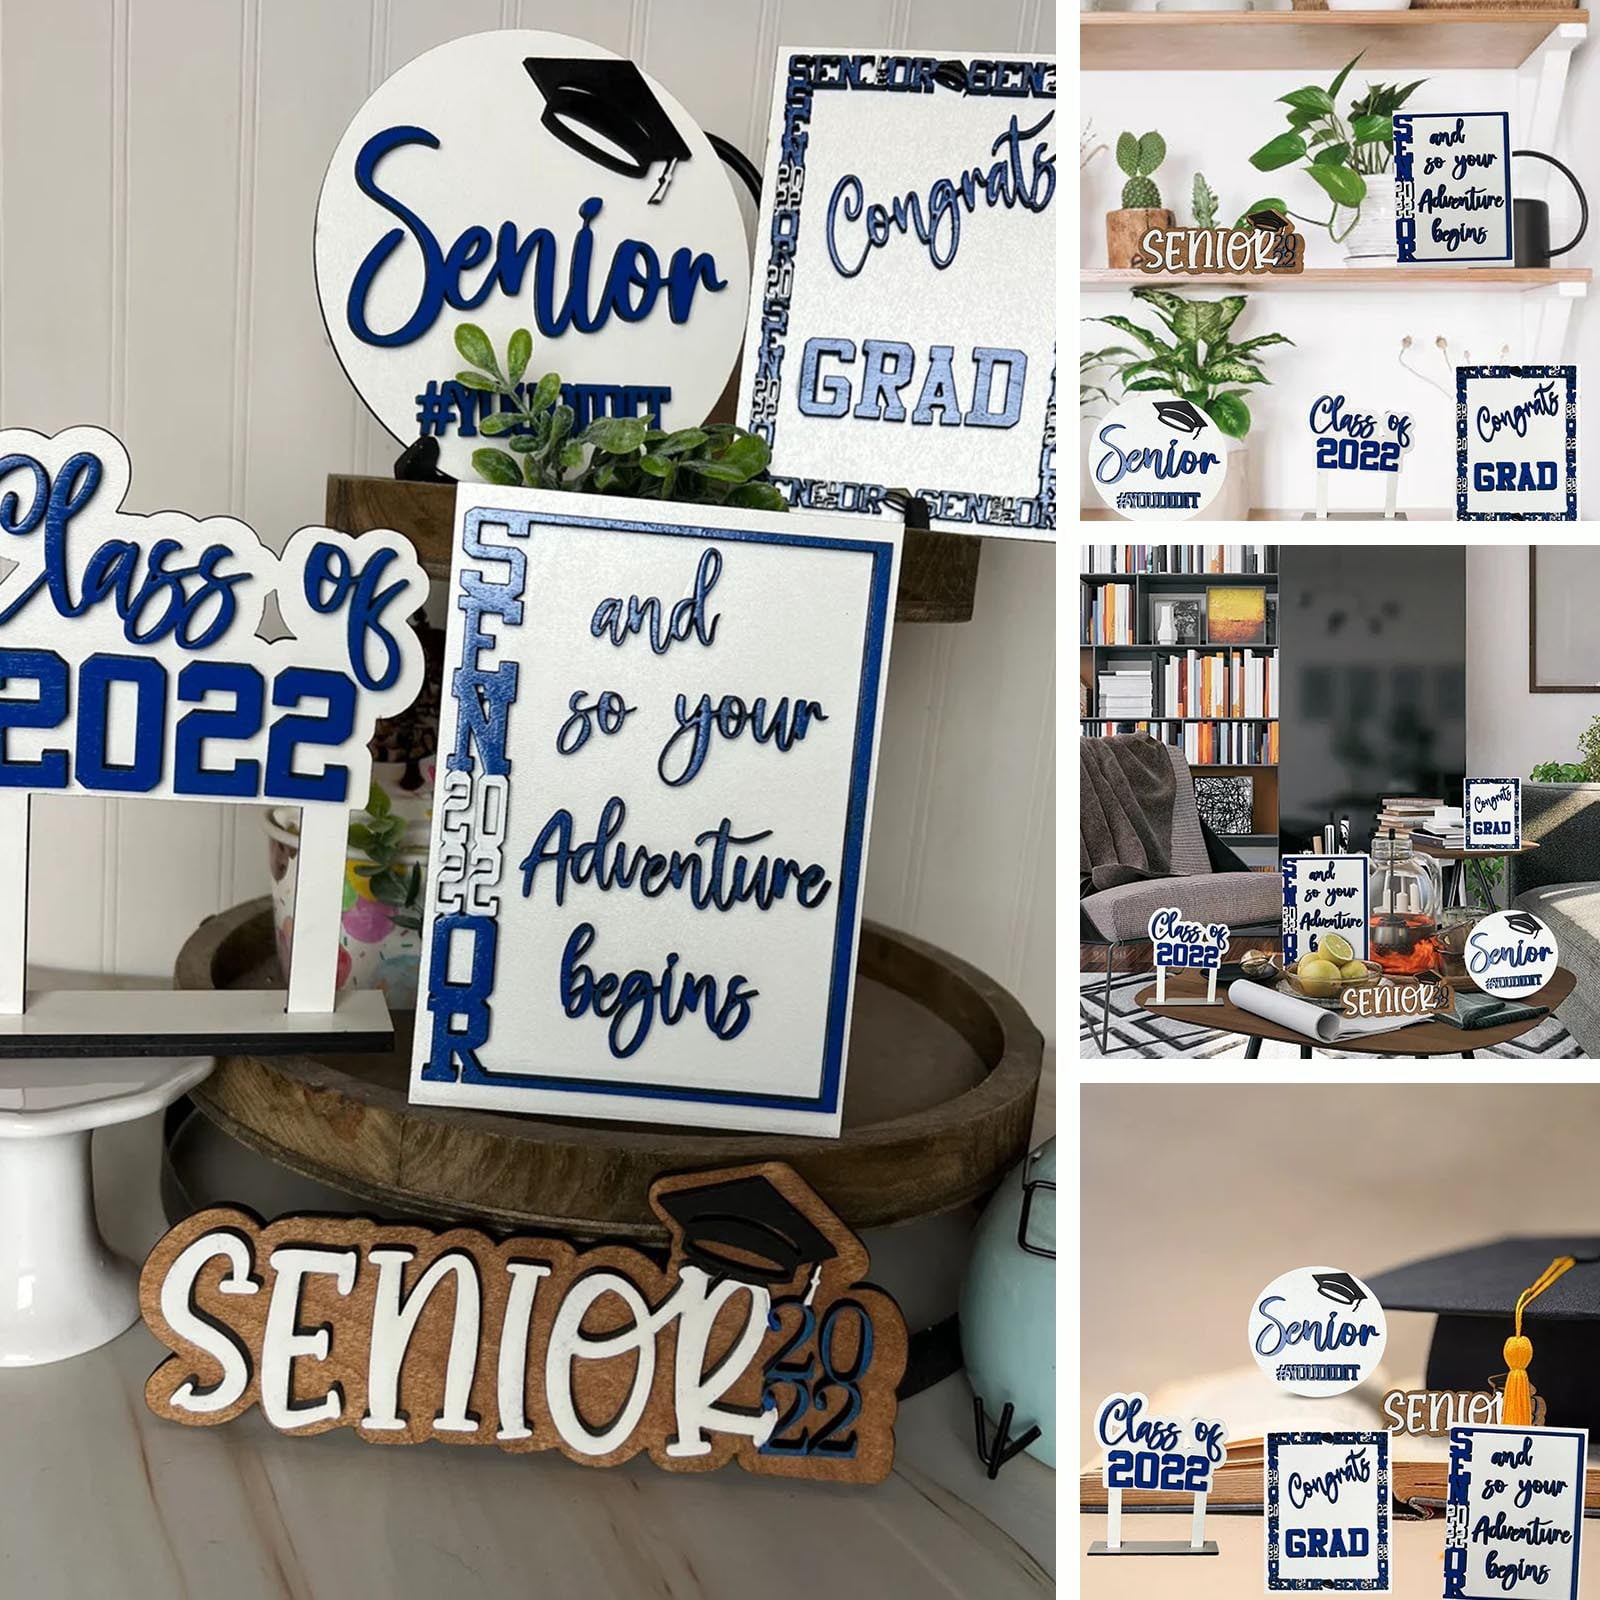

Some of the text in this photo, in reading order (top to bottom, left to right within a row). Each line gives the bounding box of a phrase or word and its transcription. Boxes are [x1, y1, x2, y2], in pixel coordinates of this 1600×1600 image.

[1429, 118, 1465, 147] and
[1424, 153, 1497, 180] so your
[826, 109, 1056, 279] Congrats
[1417, 184, 1504, 214] Adventure
[347, 126, 728, 348] Senior
[1142, 229, 1278, 271] SENIOR
[1431, 217, 1488, 252] begins
[798, 337, 1028, 429] GRAD
[1309, 395, 1412, 448] Class of
[1477, 381, 1559, 442] Congrats
[1096, 424, 1221, 484] Senior
[1316, 437, 1400, 472] 2022
[1474, 461, 1558, 492] GRAD
[303, 541, 409, 691] of
[590, 547, 722, 655] and
[0, 647, 358, 803] 2022
[556, 690, 829, 787] so your
[1474, 785, 1512, 813] Congrats
[1473, 821, 1511, 835] GRAD
[518, 796, 832, 911] Adventure
[1308, 861, 1336, 882] and
[1304, 887, 1359, 907] so your
[1152, 911, 1227, 950] Class of
[1299, 908, 1363, 931] Adventure
[1157, 942, 1219, 968] 2022
[1470, 932, 1554, 973] Senior
[560, 922, 759, 1059] begins
[1343, 983, 1437, 1016] SENIOR
[160, 1231, 779, 1458] SENIOR
[767, 1295, 874, 1385] 20
[1256, 1296, 1380, 1357] Senior
[760, 1378, 862, 1459] 22
[1099, 1398, 1223, 1462] Class of
[1384, 1391, 1504, 1433] SENIO
[1108, 1450, 1210, 1491] 2022
[1491, 1436, 1533, 1469] and
[1288, 1447, 1370, 1509] Congrats
[1481, 1479, 1568, 1508] so your
[1285, 1528, 1369, 1558] GRAD
[1472, 1511, 1572, 1545] Adventure
[1485, 1550, 1551, 1591] begins
